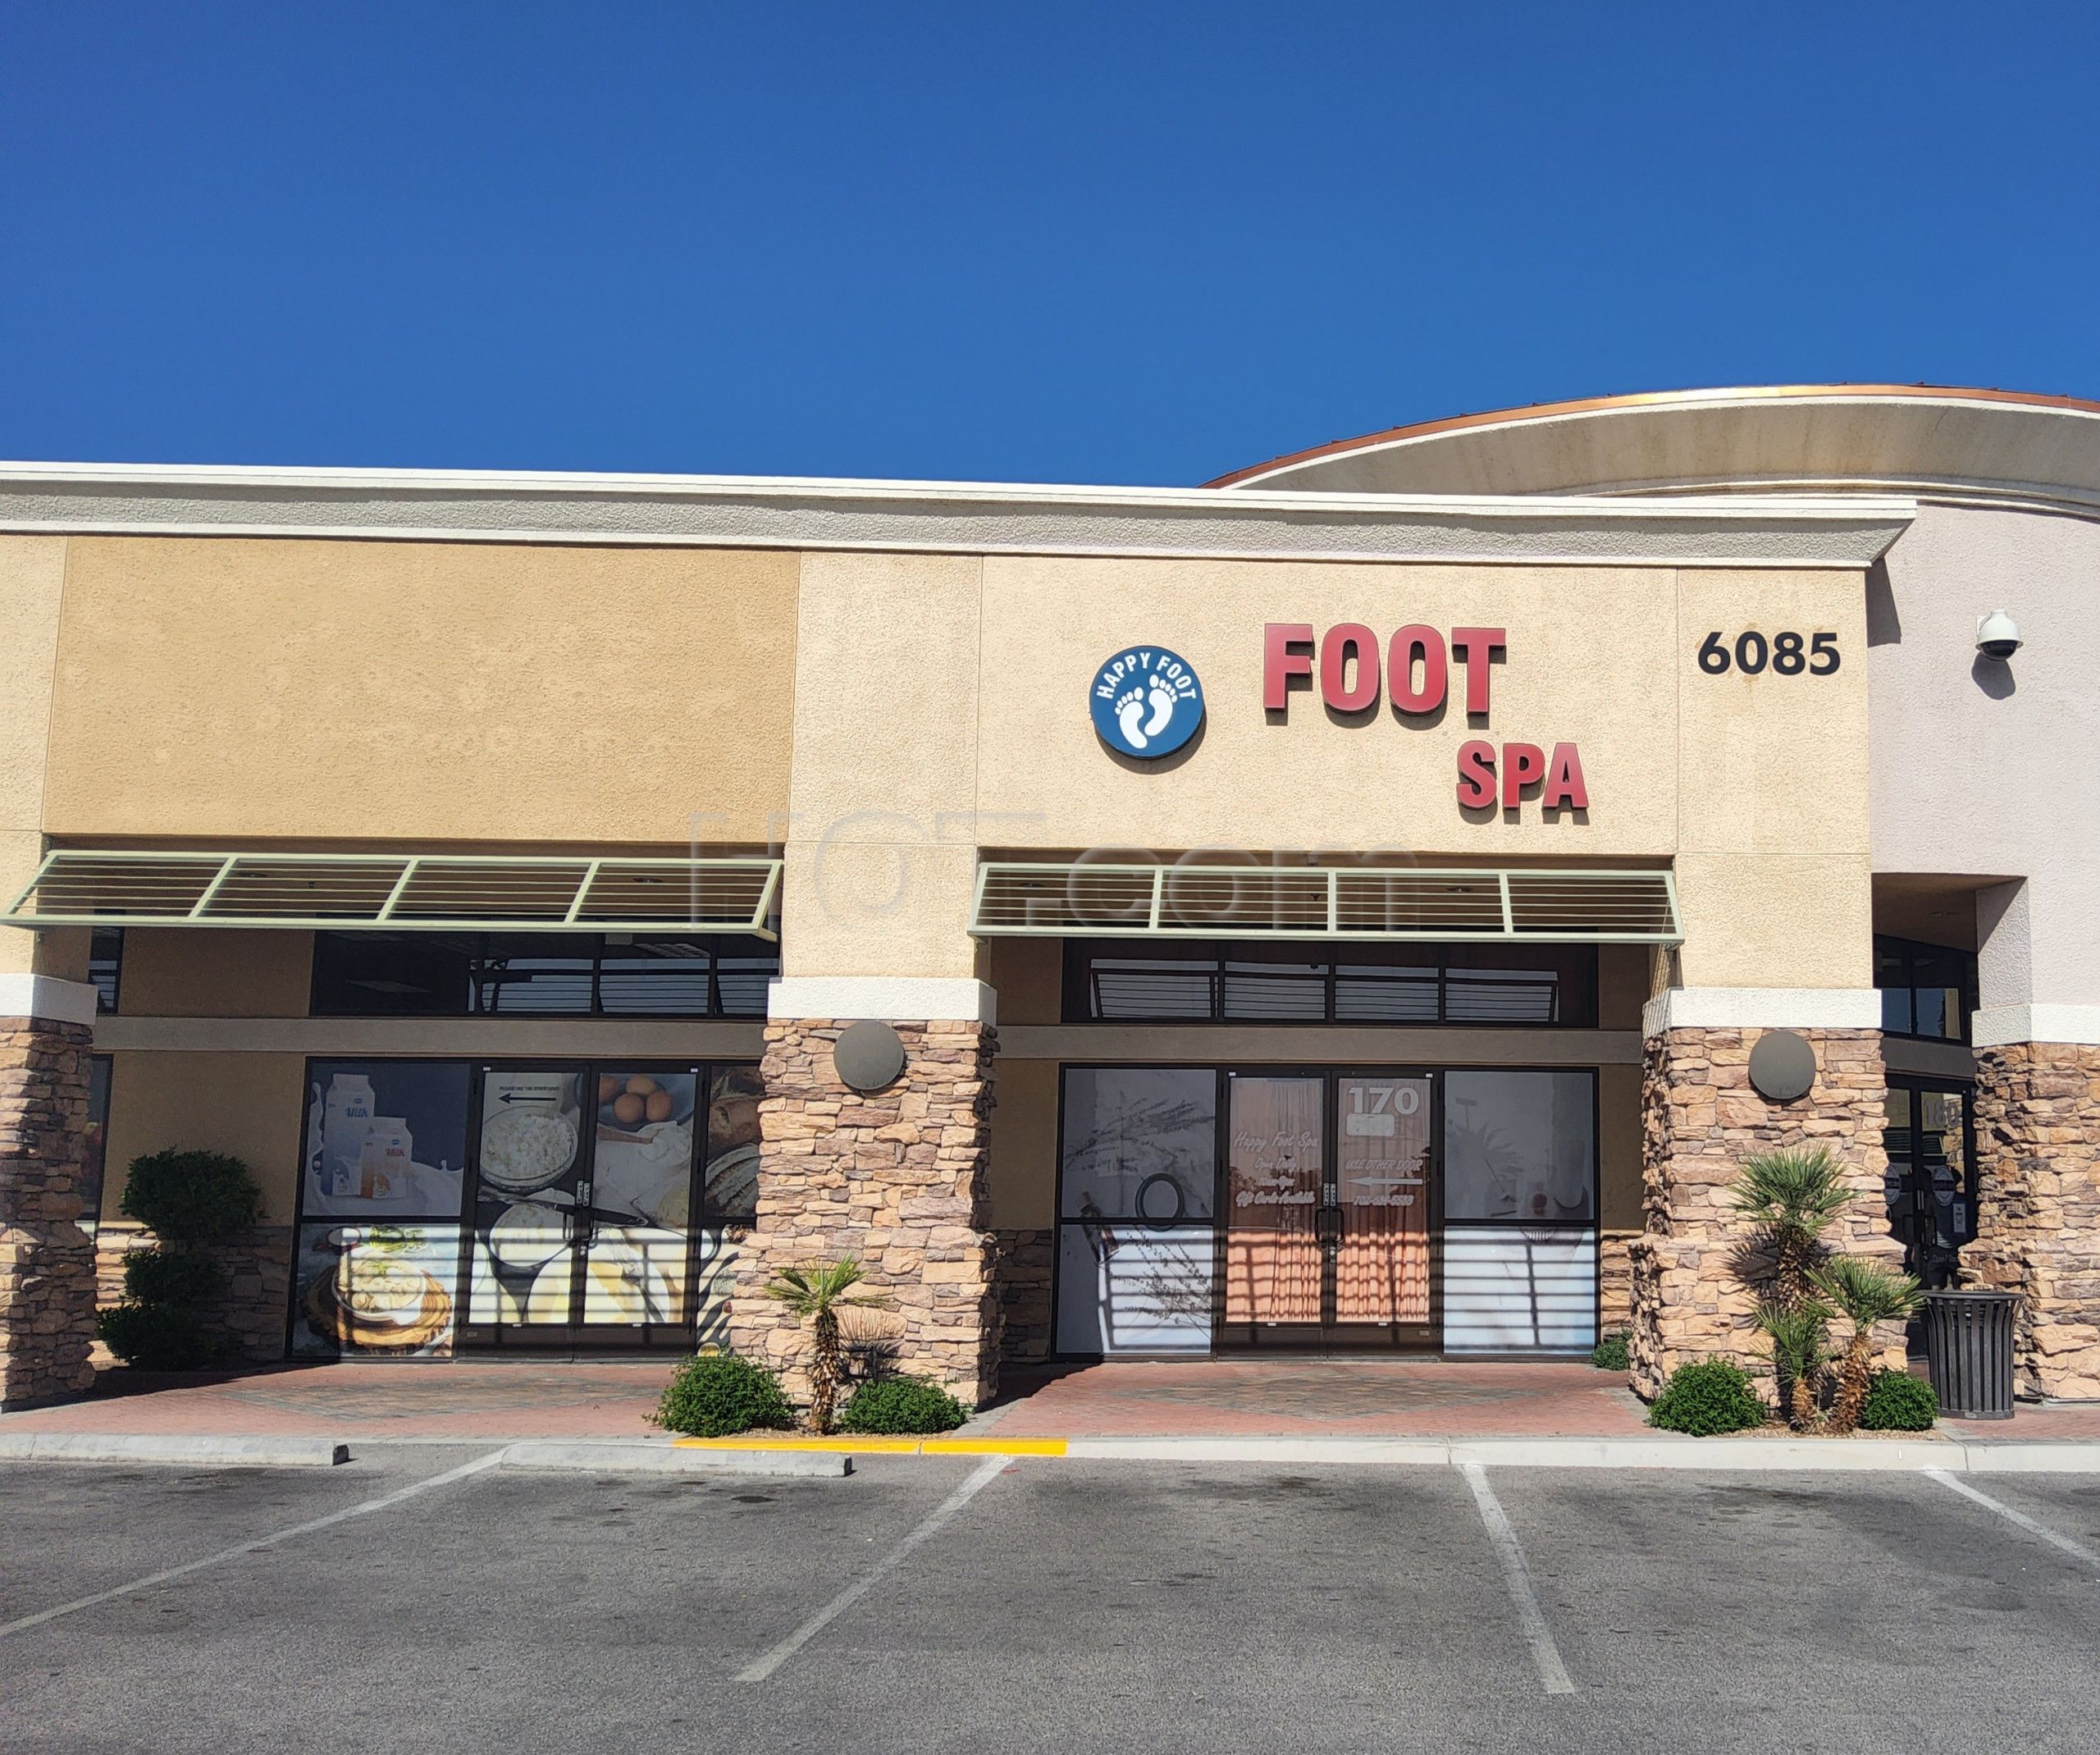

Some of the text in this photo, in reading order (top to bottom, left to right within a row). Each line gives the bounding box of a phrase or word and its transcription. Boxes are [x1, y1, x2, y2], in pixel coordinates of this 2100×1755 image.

[1096, 652, 1197, 699] HAPPY FOOT
[1263, 623, 1507, 714] FOOT
[1697, 631, 1842, 676] 6085
[1456, 740, 1589, 810] SPA
[1349, 1087, 1419, 1114] 170
[1234, 1131, 1318, 1153] Happy Foot Spa
[1346, 1159, 1424, 1172] USE OTHER DOOR
